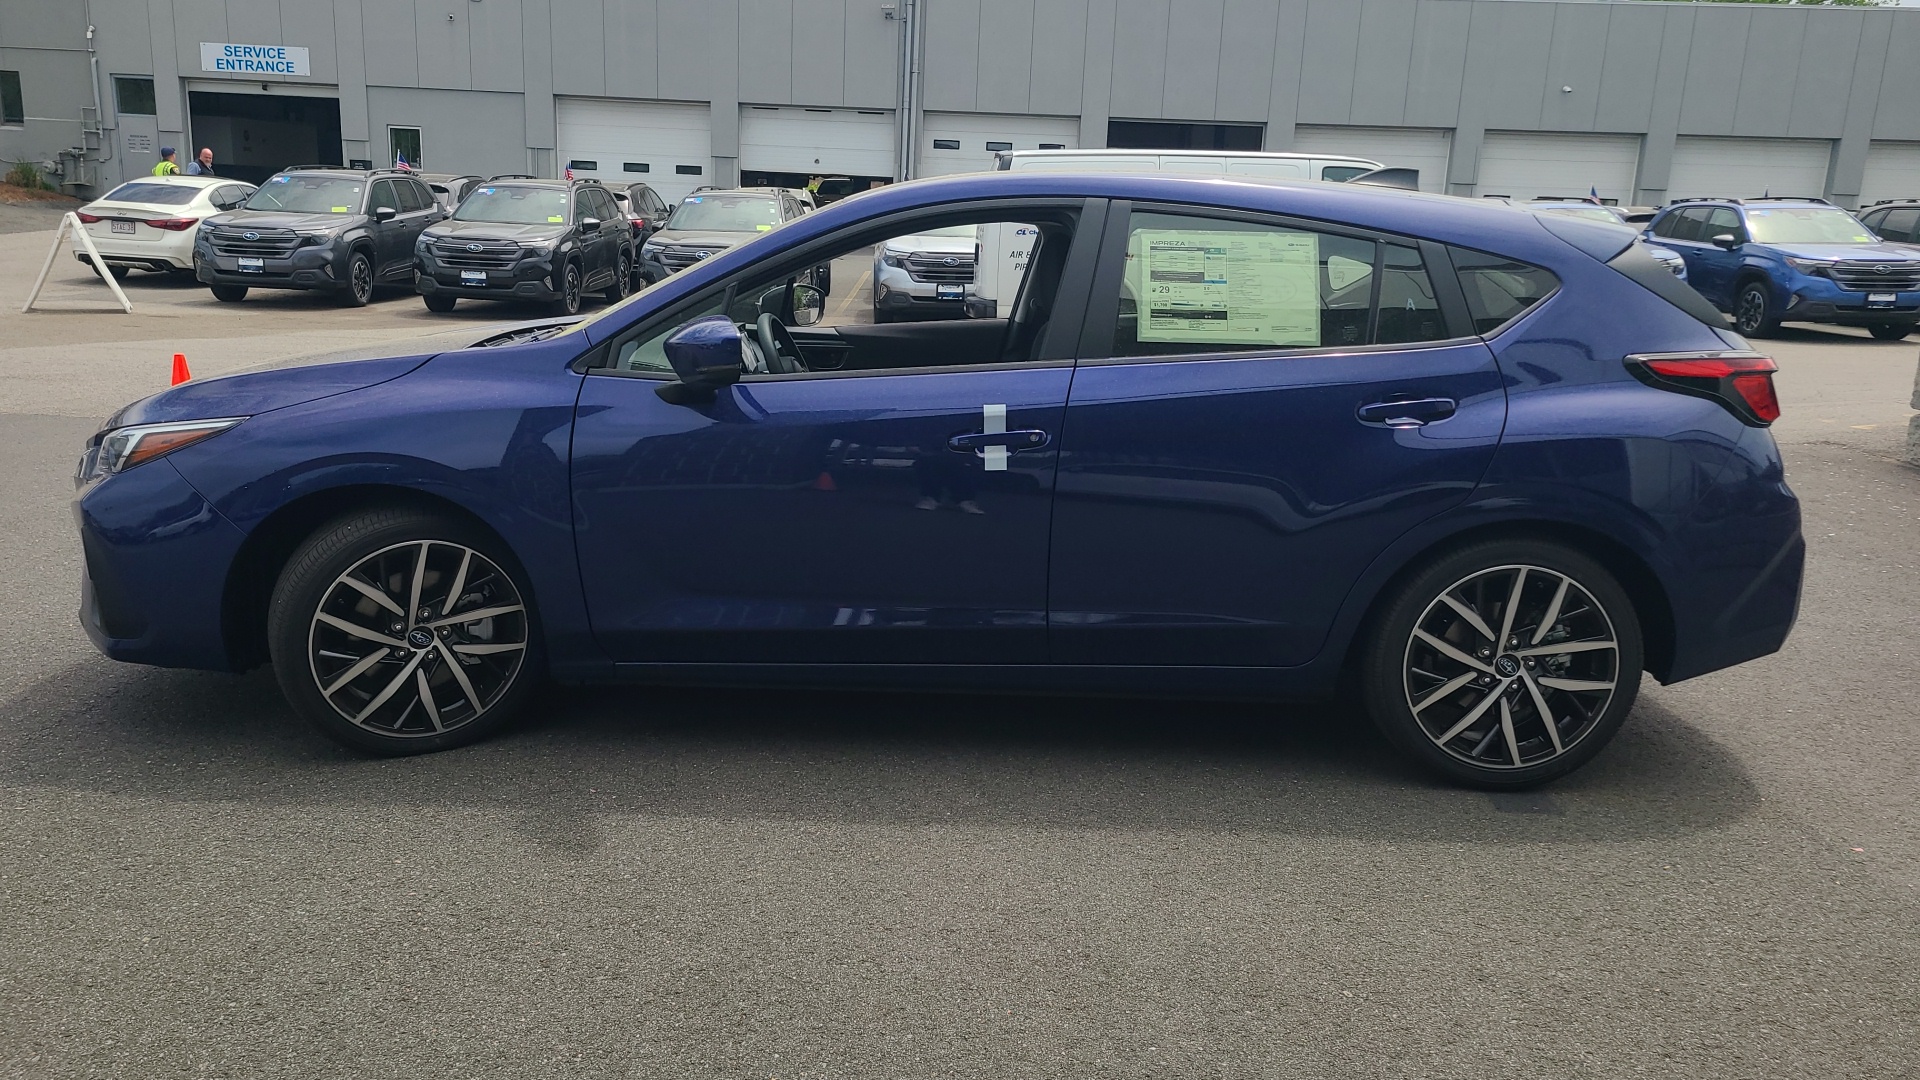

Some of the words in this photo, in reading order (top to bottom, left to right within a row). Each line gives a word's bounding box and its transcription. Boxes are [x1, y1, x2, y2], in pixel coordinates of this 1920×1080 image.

[224, 45, 287, 60] SERVICE
[216, 58, 295, 73] ENTRANCE
[1009, 250, 1024, 259] AIR
[1159, 285, 1170, 294] 29
